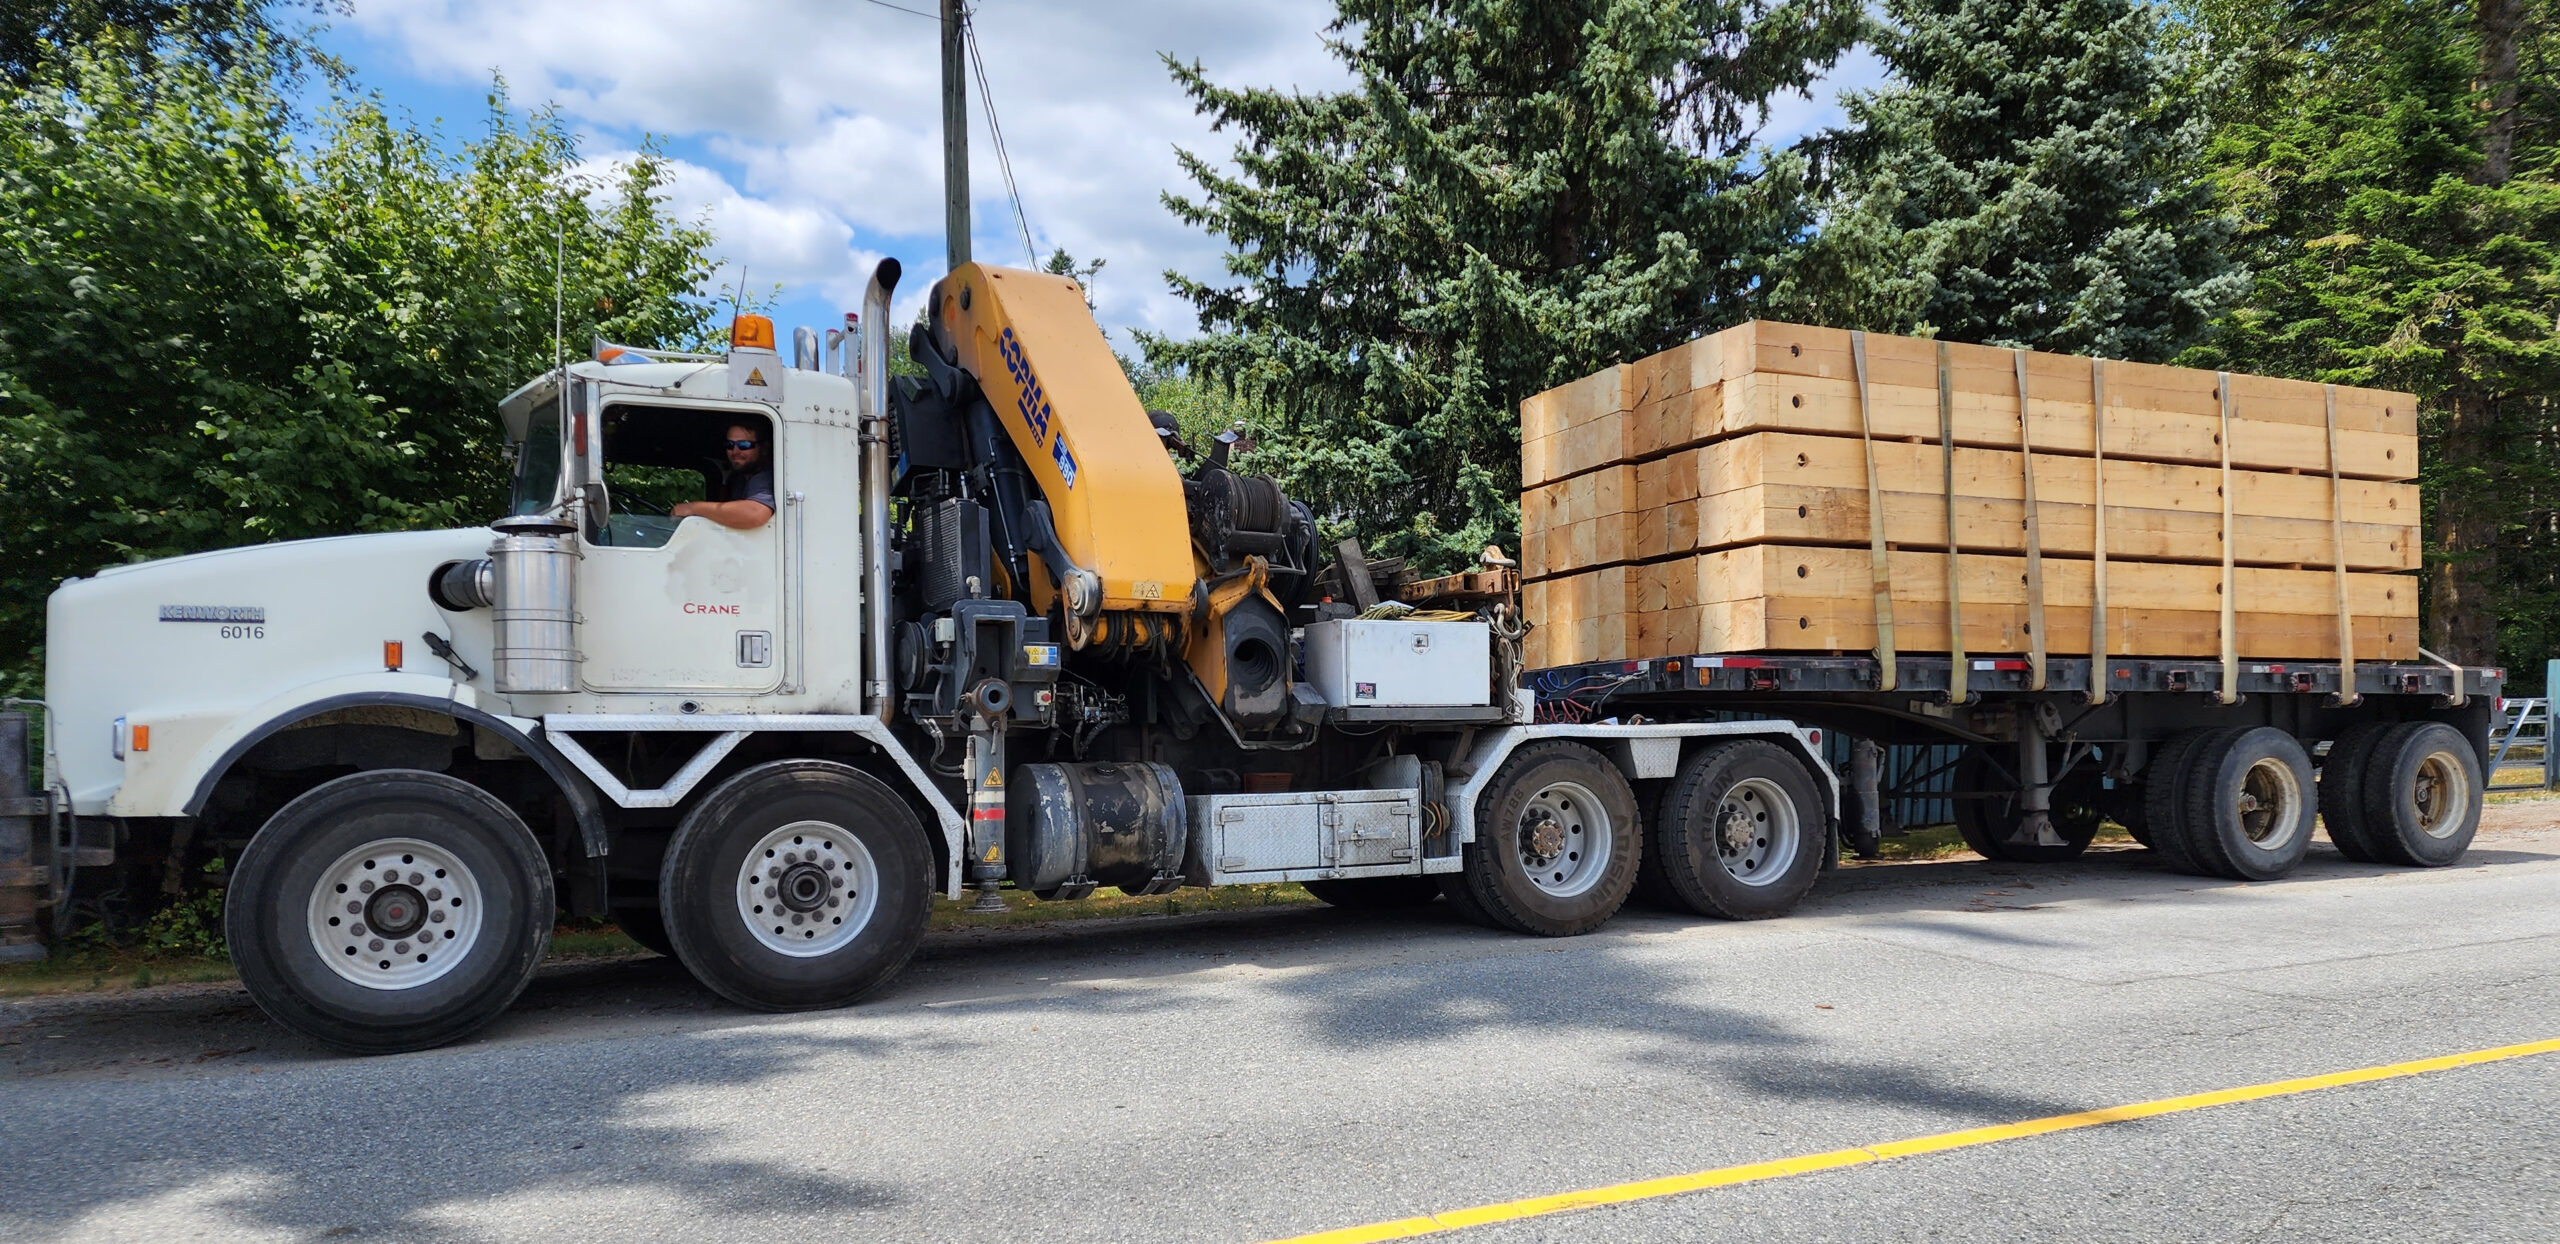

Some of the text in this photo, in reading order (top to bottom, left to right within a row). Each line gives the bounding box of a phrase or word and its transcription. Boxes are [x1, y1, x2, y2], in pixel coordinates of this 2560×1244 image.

[999, 326, 1051, 439] COPMA
[1057, 454, 1076, 488] 990
[159, 605, 265, 621] KENWORTH
[683, 602, 741, 615] CRANE
[221, 625, 264, 640] 6016
